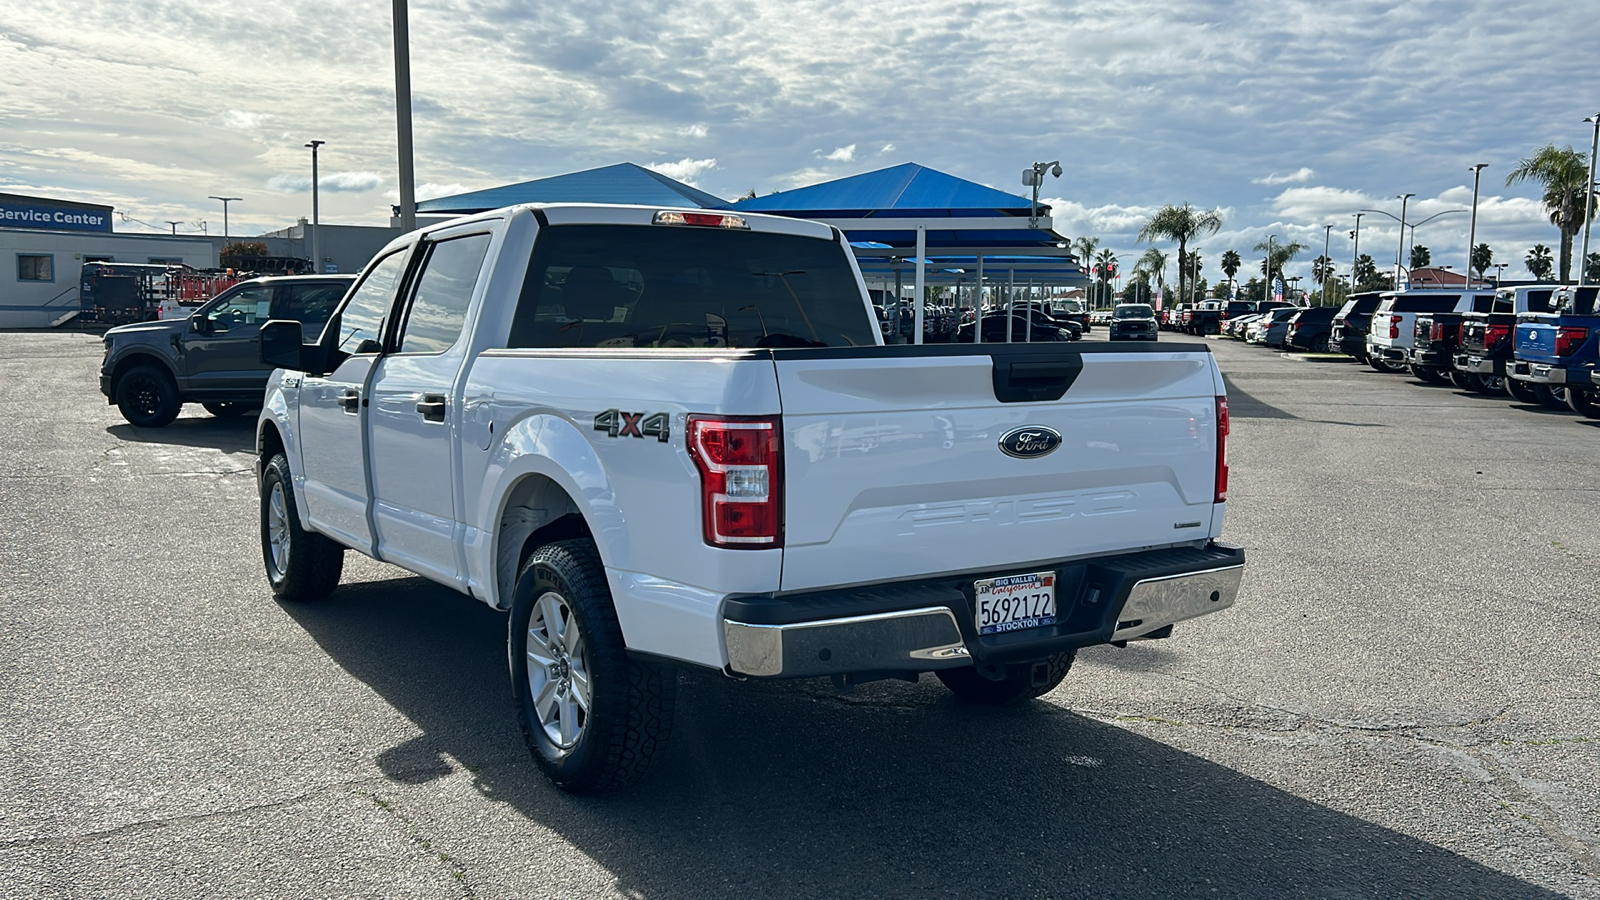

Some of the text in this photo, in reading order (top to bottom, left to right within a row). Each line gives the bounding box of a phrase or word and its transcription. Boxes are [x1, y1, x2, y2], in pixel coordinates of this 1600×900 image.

[0, 208, 104, 225] Service Center
[1015, 432, 1050, 452] Ford
[1010, 575, 1037, 584] VALLEY
[992, 582, 1041, 596] California
[996, 619, 1039, 632] STOCKTON
